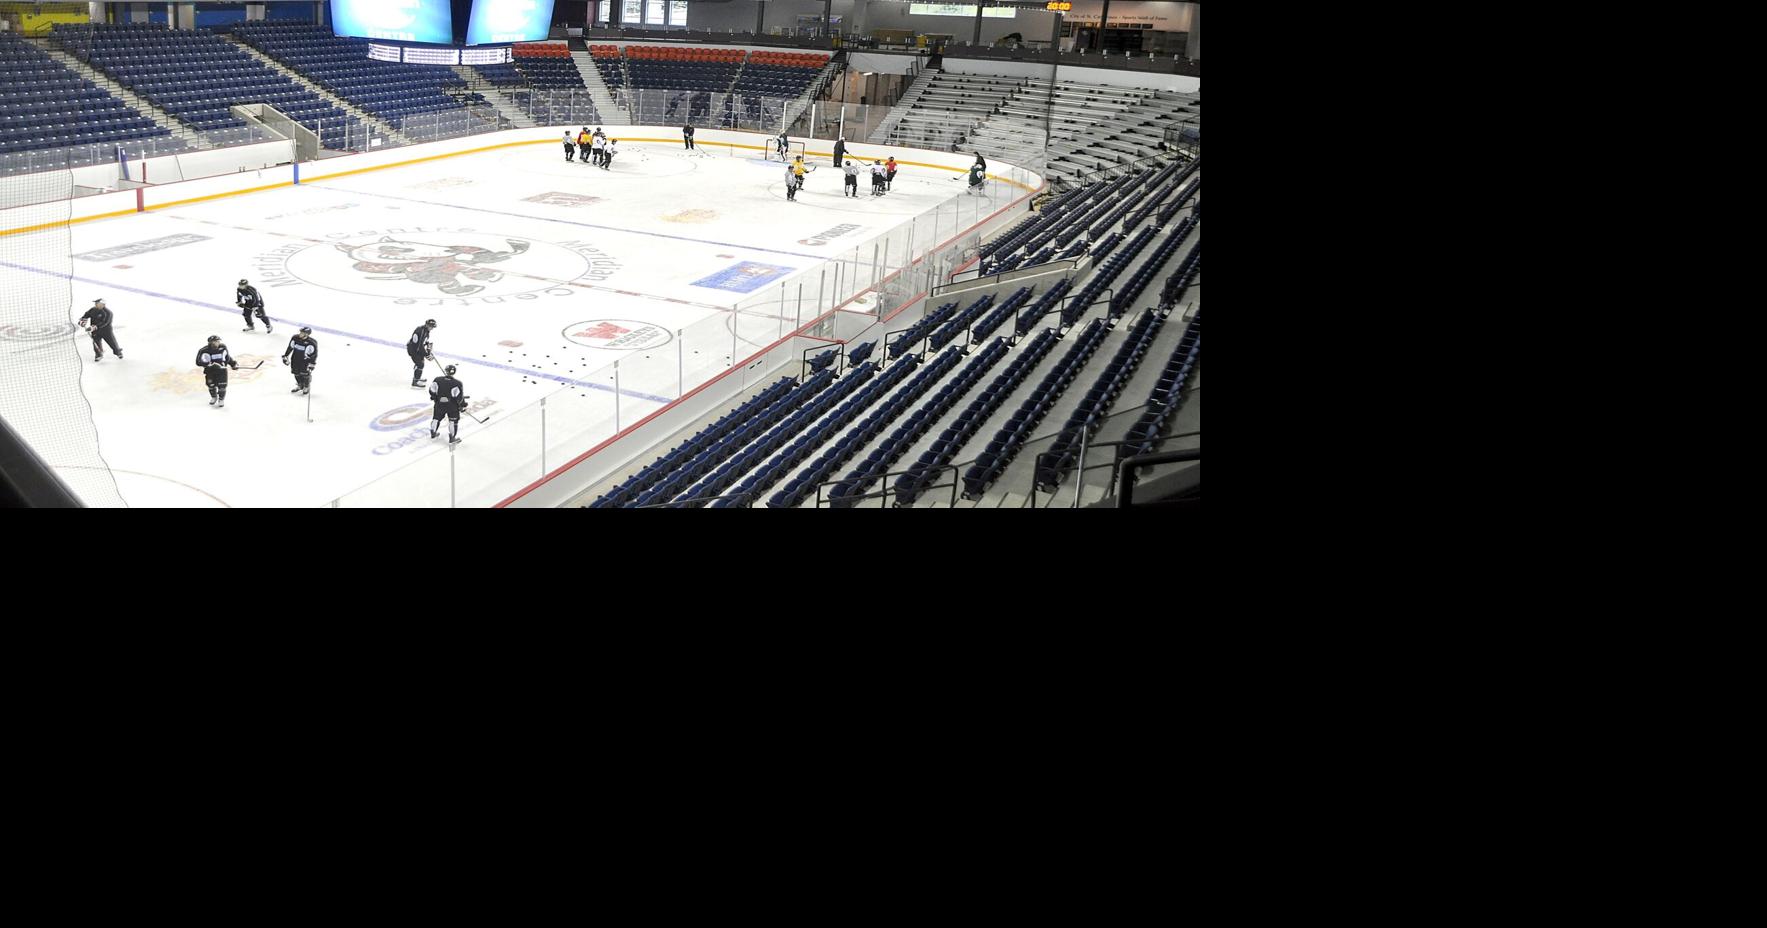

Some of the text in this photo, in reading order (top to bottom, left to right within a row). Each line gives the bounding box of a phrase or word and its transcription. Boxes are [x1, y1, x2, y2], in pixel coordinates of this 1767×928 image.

[1046, 2, 1070, 11] 20:00
[325, 226, 478, 239] Centre
[253, 242, 308, 287] Meridian
[558, 239, 624, 282] Meridian
[393, 287, 576, 306] Centre
